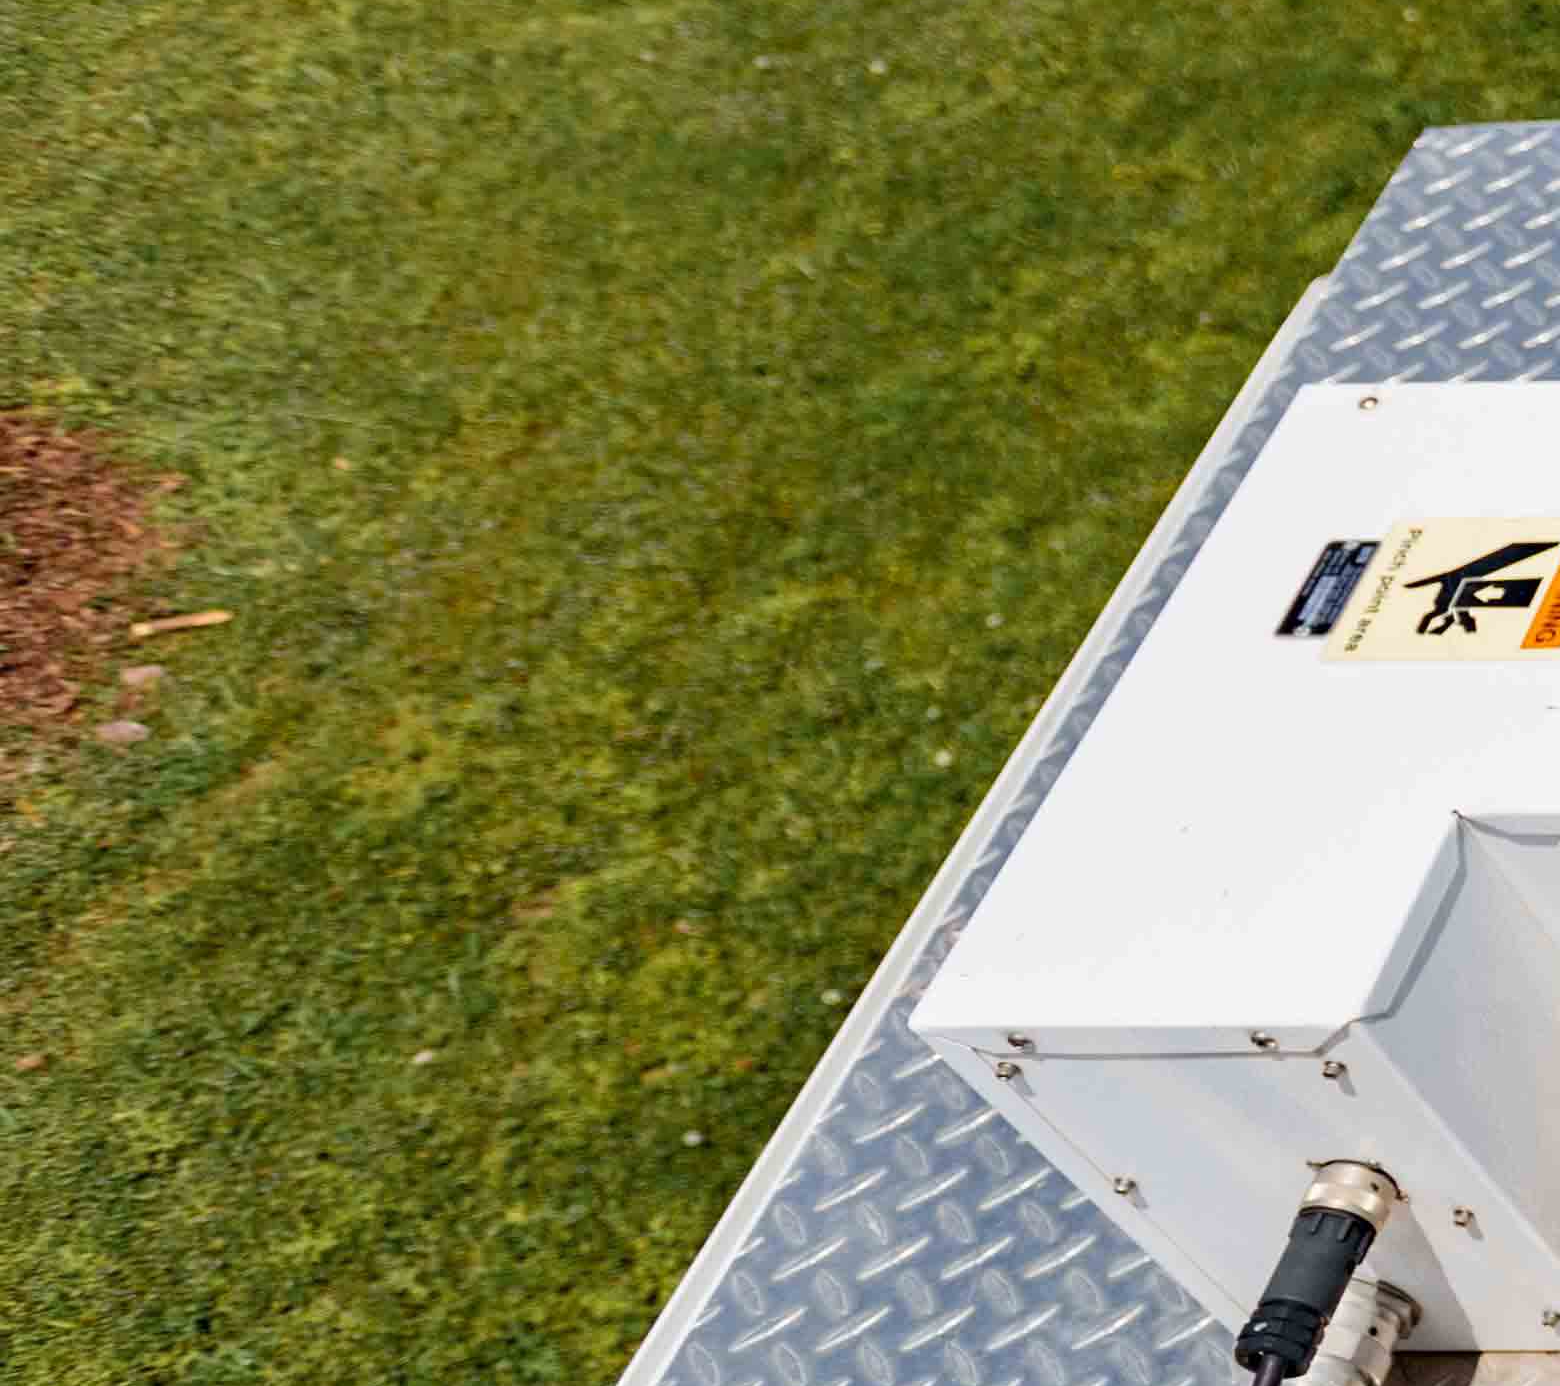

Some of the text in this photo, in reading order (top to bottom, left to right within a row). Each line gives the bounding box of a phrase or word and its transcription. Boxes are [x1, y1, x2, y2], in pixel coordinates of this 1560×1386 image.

[1345, 528, 1423, 652] Pinch point area
